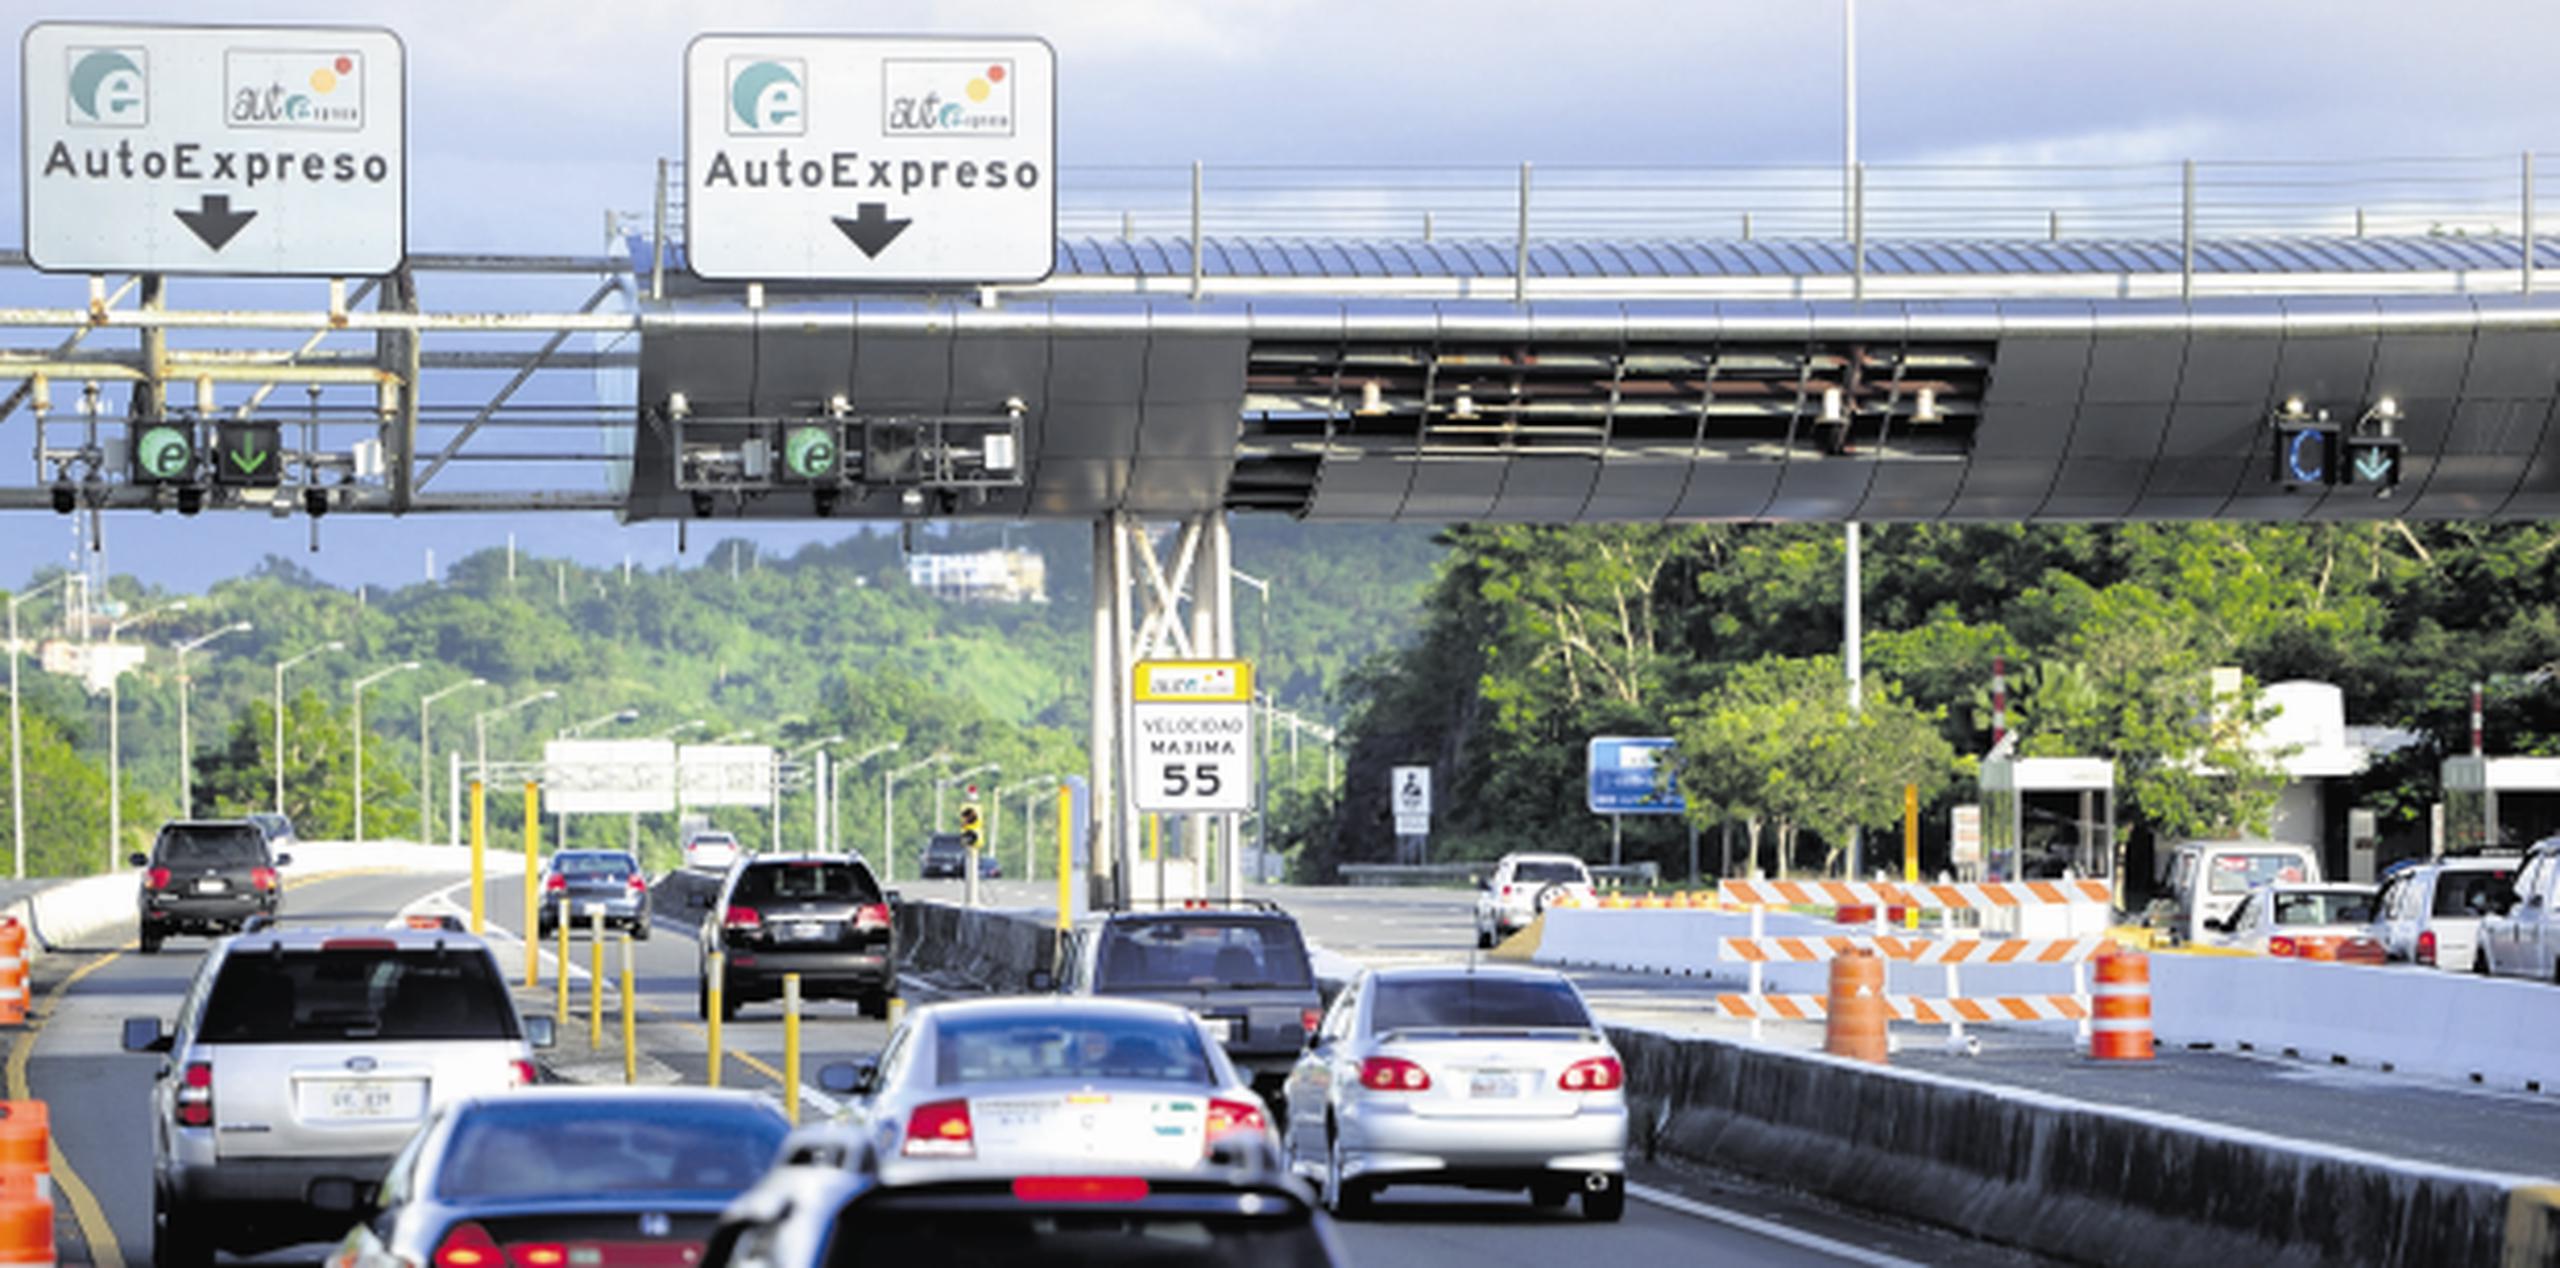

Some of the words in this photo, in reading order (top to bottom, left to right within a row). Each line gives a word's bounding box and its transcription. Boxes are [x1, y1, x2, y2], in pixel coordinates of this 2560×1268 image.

[44, 139, 388, 188] AutoExpreso
[704, 148, 1040, 196] AutoExpreso
[2289, 428, 2323, 482] C
[1142, 715, 1244, 735] VELOCIDAD
[1162, 763, 1222, 797] 55
